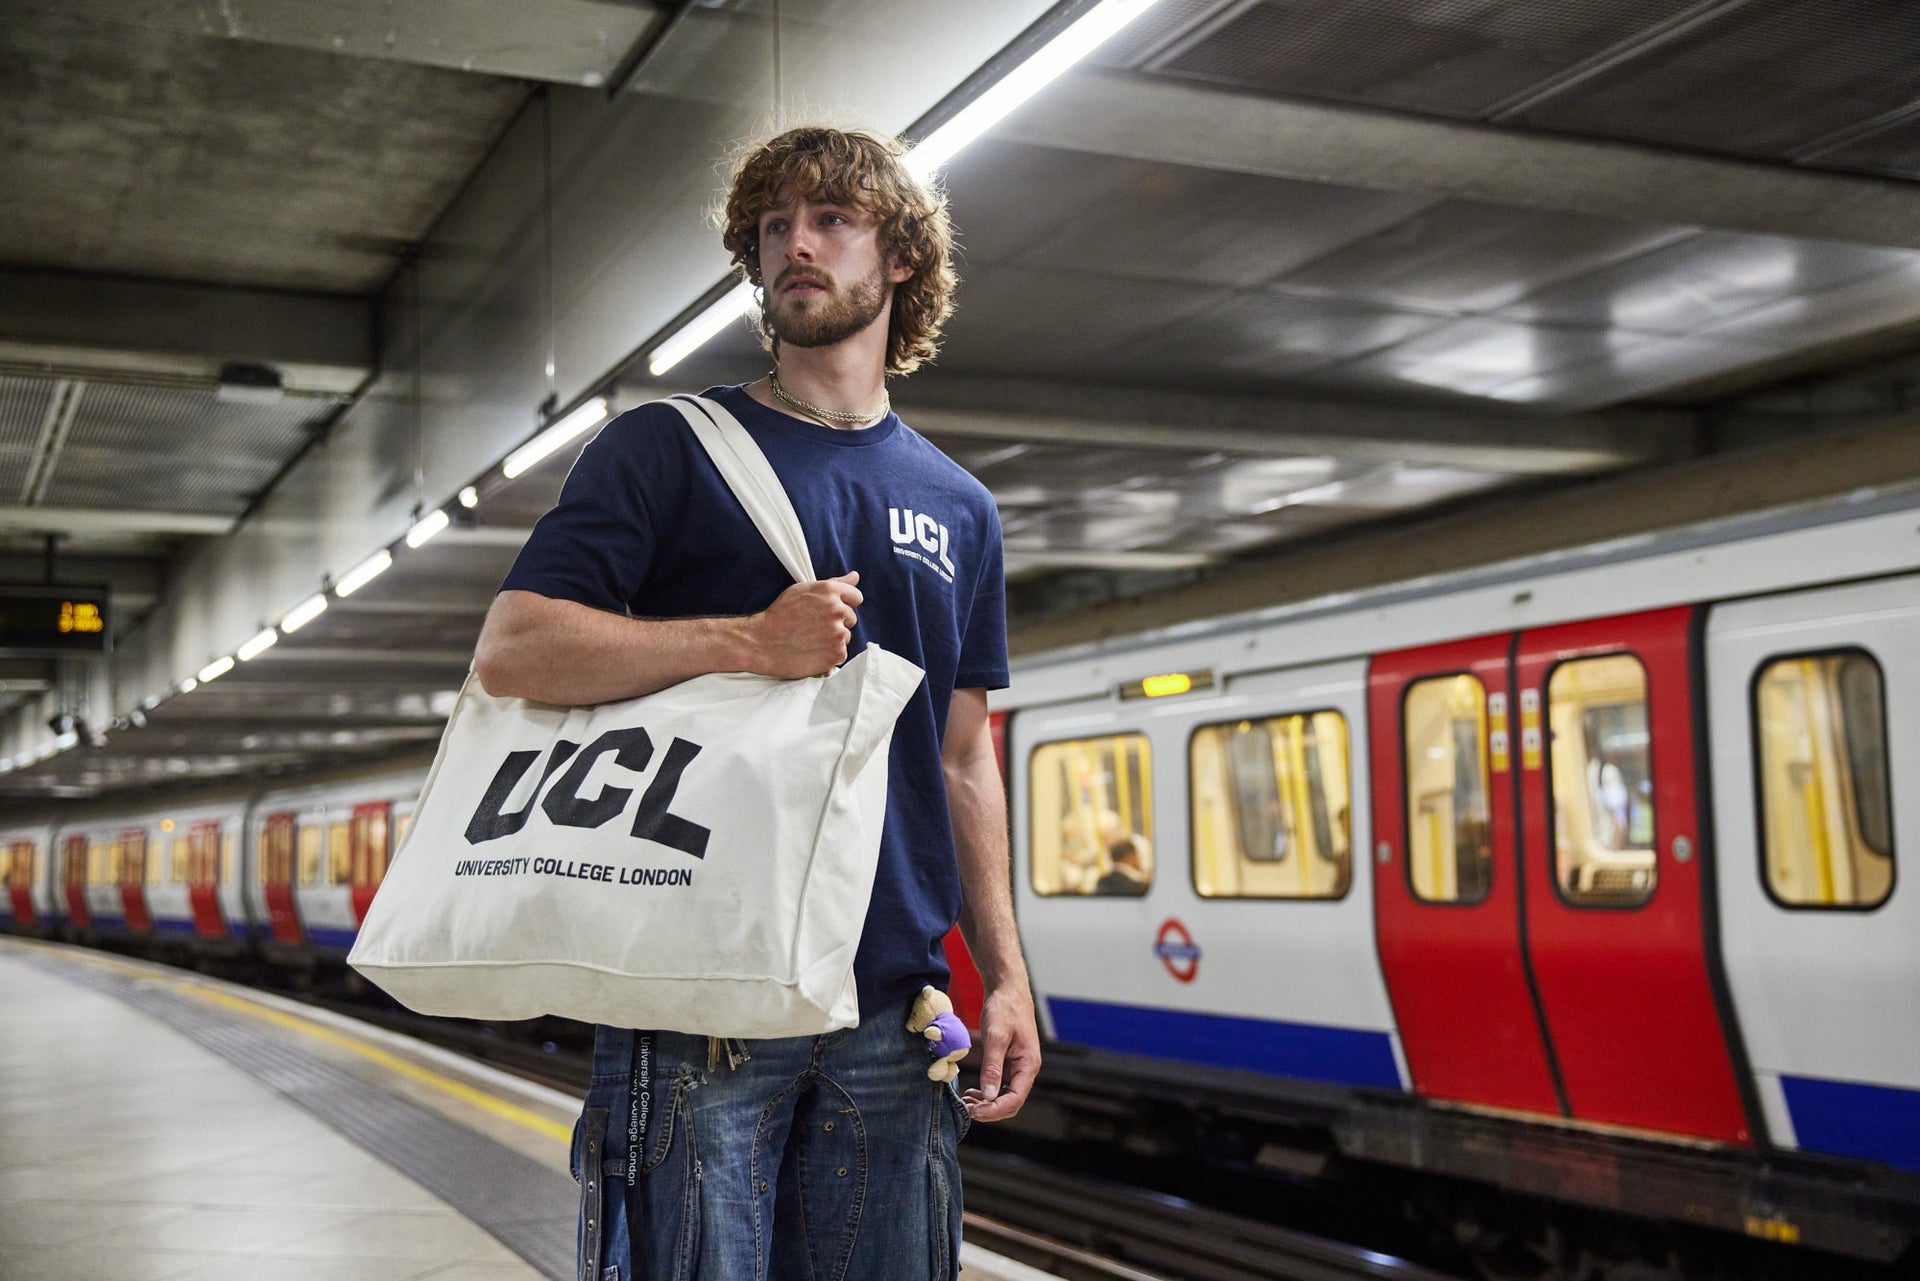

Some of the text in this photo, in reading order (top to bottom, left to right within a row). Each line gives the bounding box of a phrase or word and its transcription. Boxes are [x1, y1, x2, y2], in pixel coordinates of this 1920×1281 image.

[889, 508, 955, 578] UCL
[464, 726, 711, 860] UCL
[455, 857, 692, 887] UNIVERSITY COLLEGE LONDON
[639, 1036, 651, 1089] University
[639, 1092, 650, 1134] College
[627, 1144, 638, 1187] London
